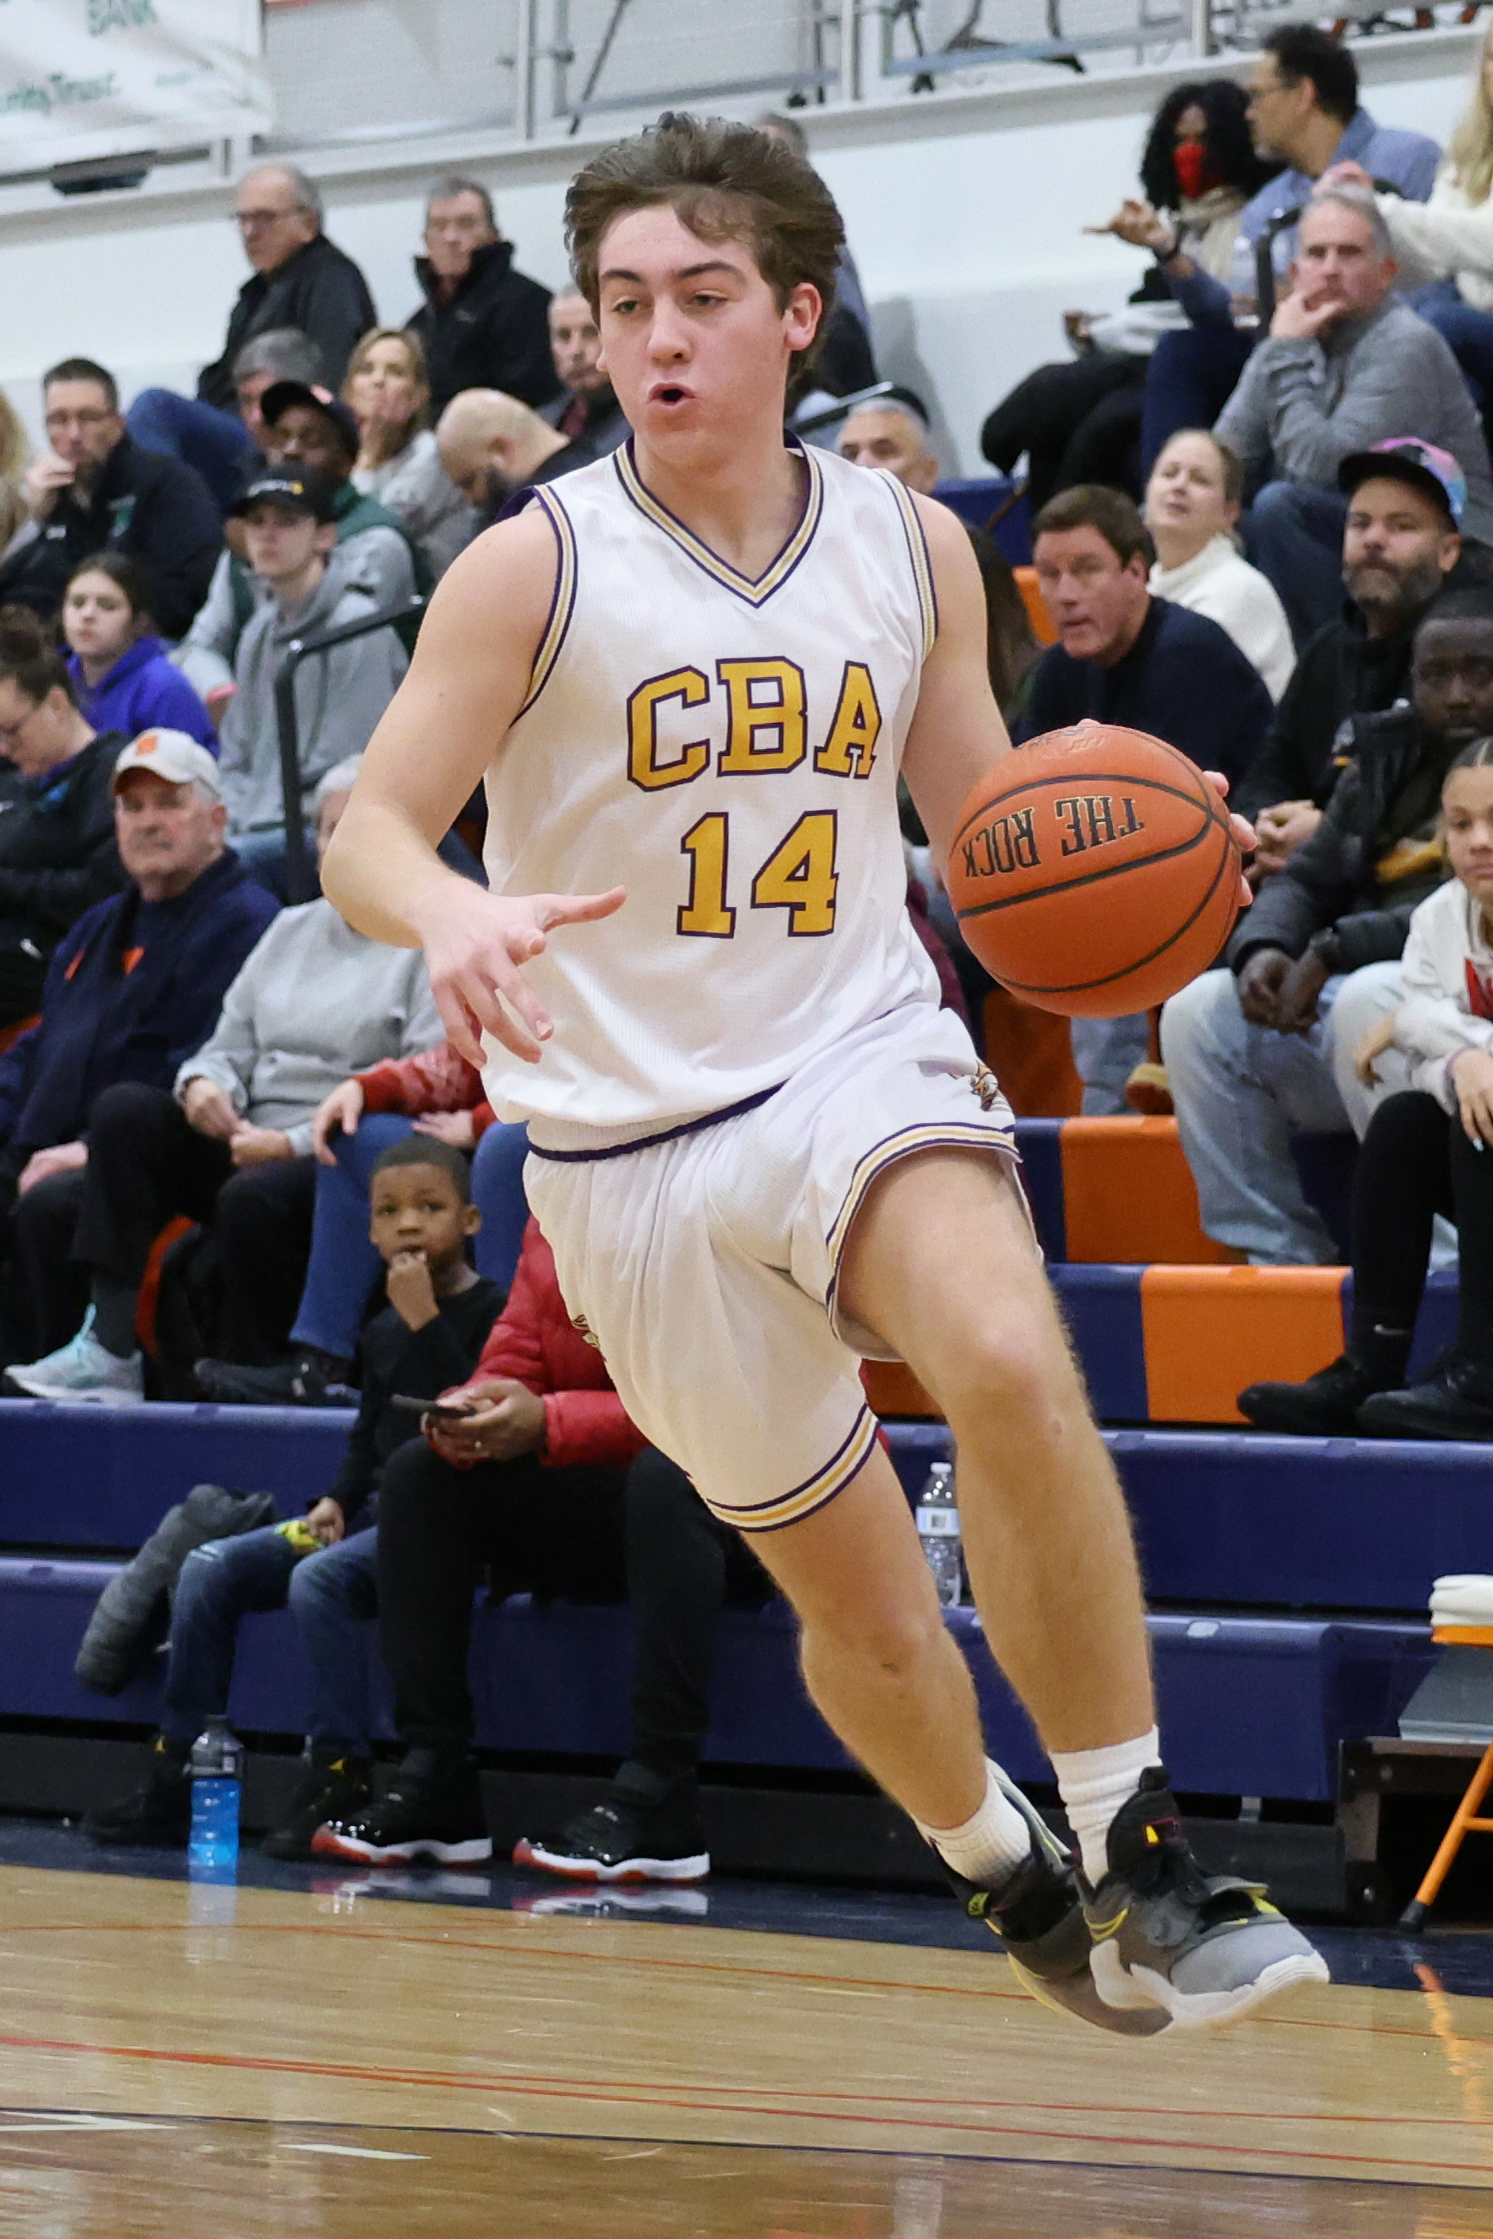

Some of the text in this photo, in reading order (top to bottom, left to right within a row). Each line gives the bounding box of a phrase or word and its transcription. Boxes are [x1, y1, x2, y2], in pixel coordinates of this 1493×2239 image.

[626, 656, 882, 792] CBA
[676, 809, 839, 938] 14
[962, 796, 1144, 878] THE ROCK
